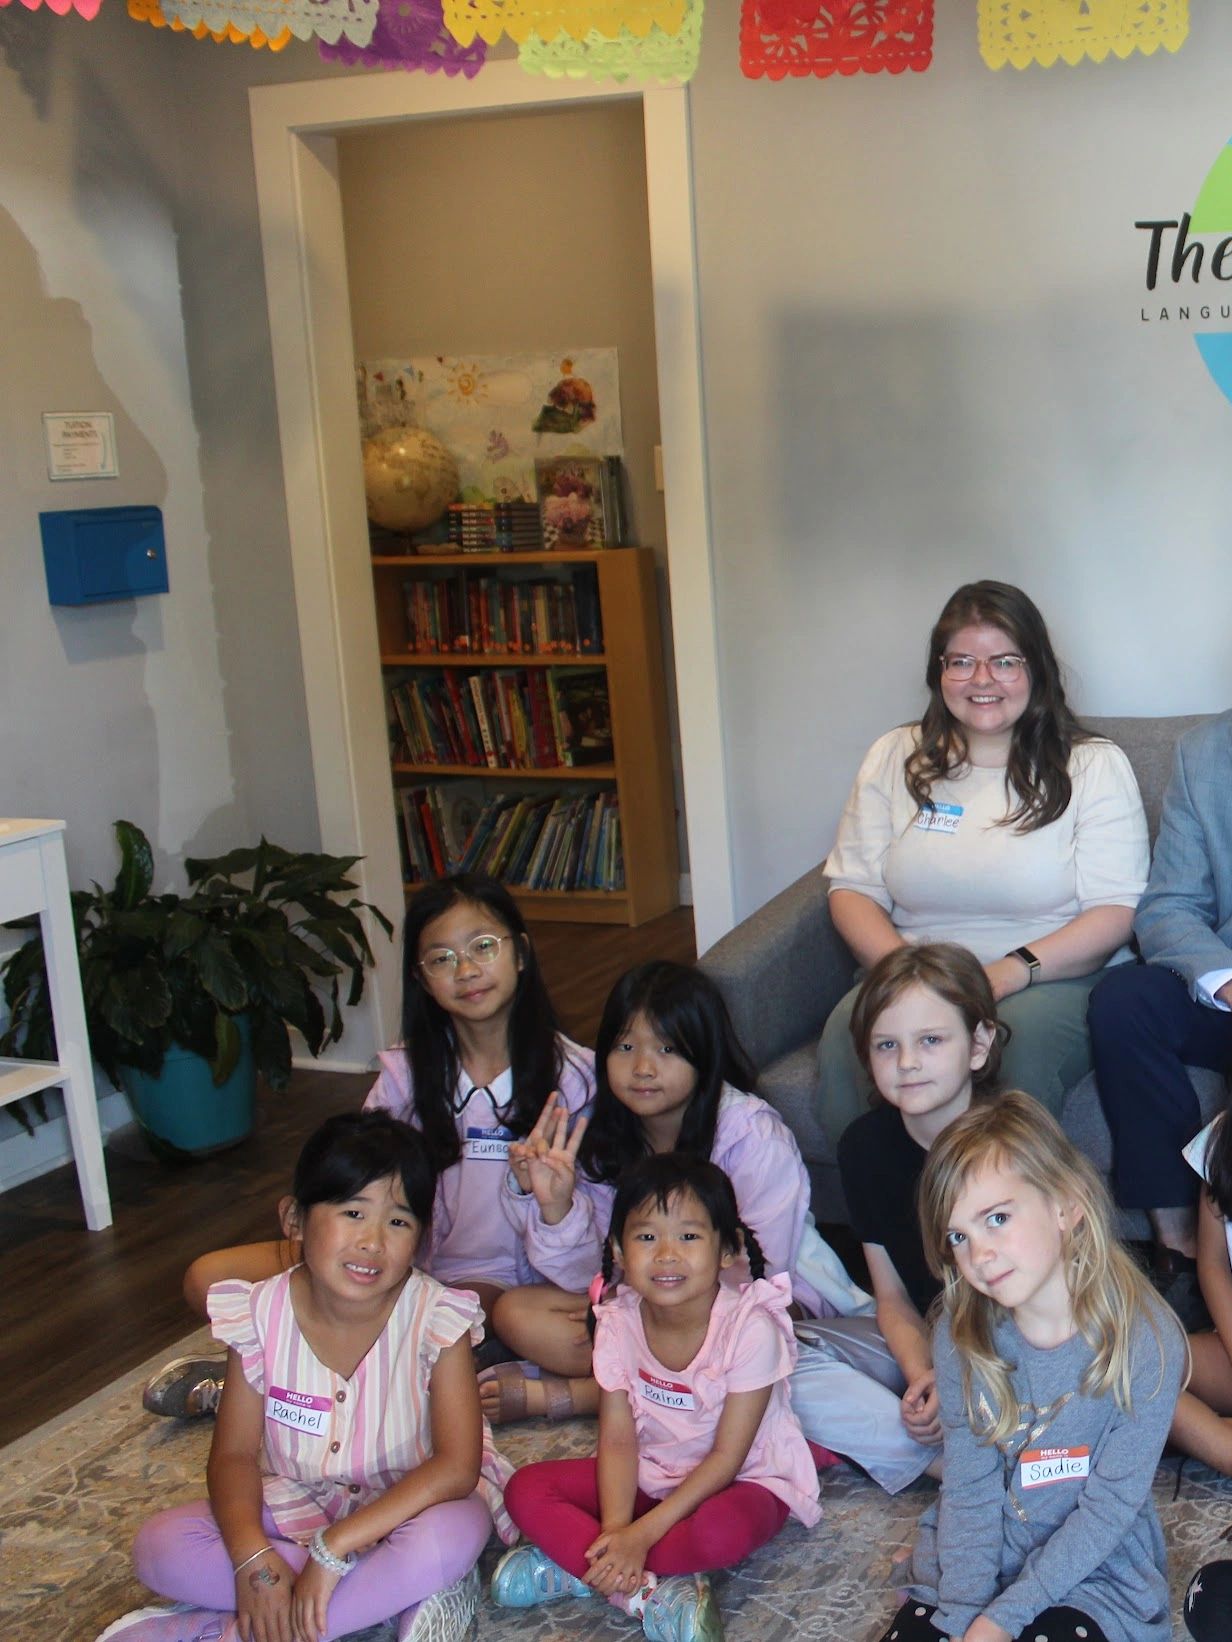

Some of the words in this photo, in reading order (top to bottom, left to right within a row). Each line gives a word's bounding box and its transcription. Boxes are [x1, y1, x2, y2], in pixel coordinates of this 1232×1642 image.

[650, 1376, 674, 1388] HELLO
[286, 1391, 313, 1404] HELLO
[644, 1384, 687, 1407] Raina
[273, 1400, 323, 1429] Rachel
[1040, 1448, 1070, 1456] HELLO
[1030, 1457, 1083, 1481] Sadie
